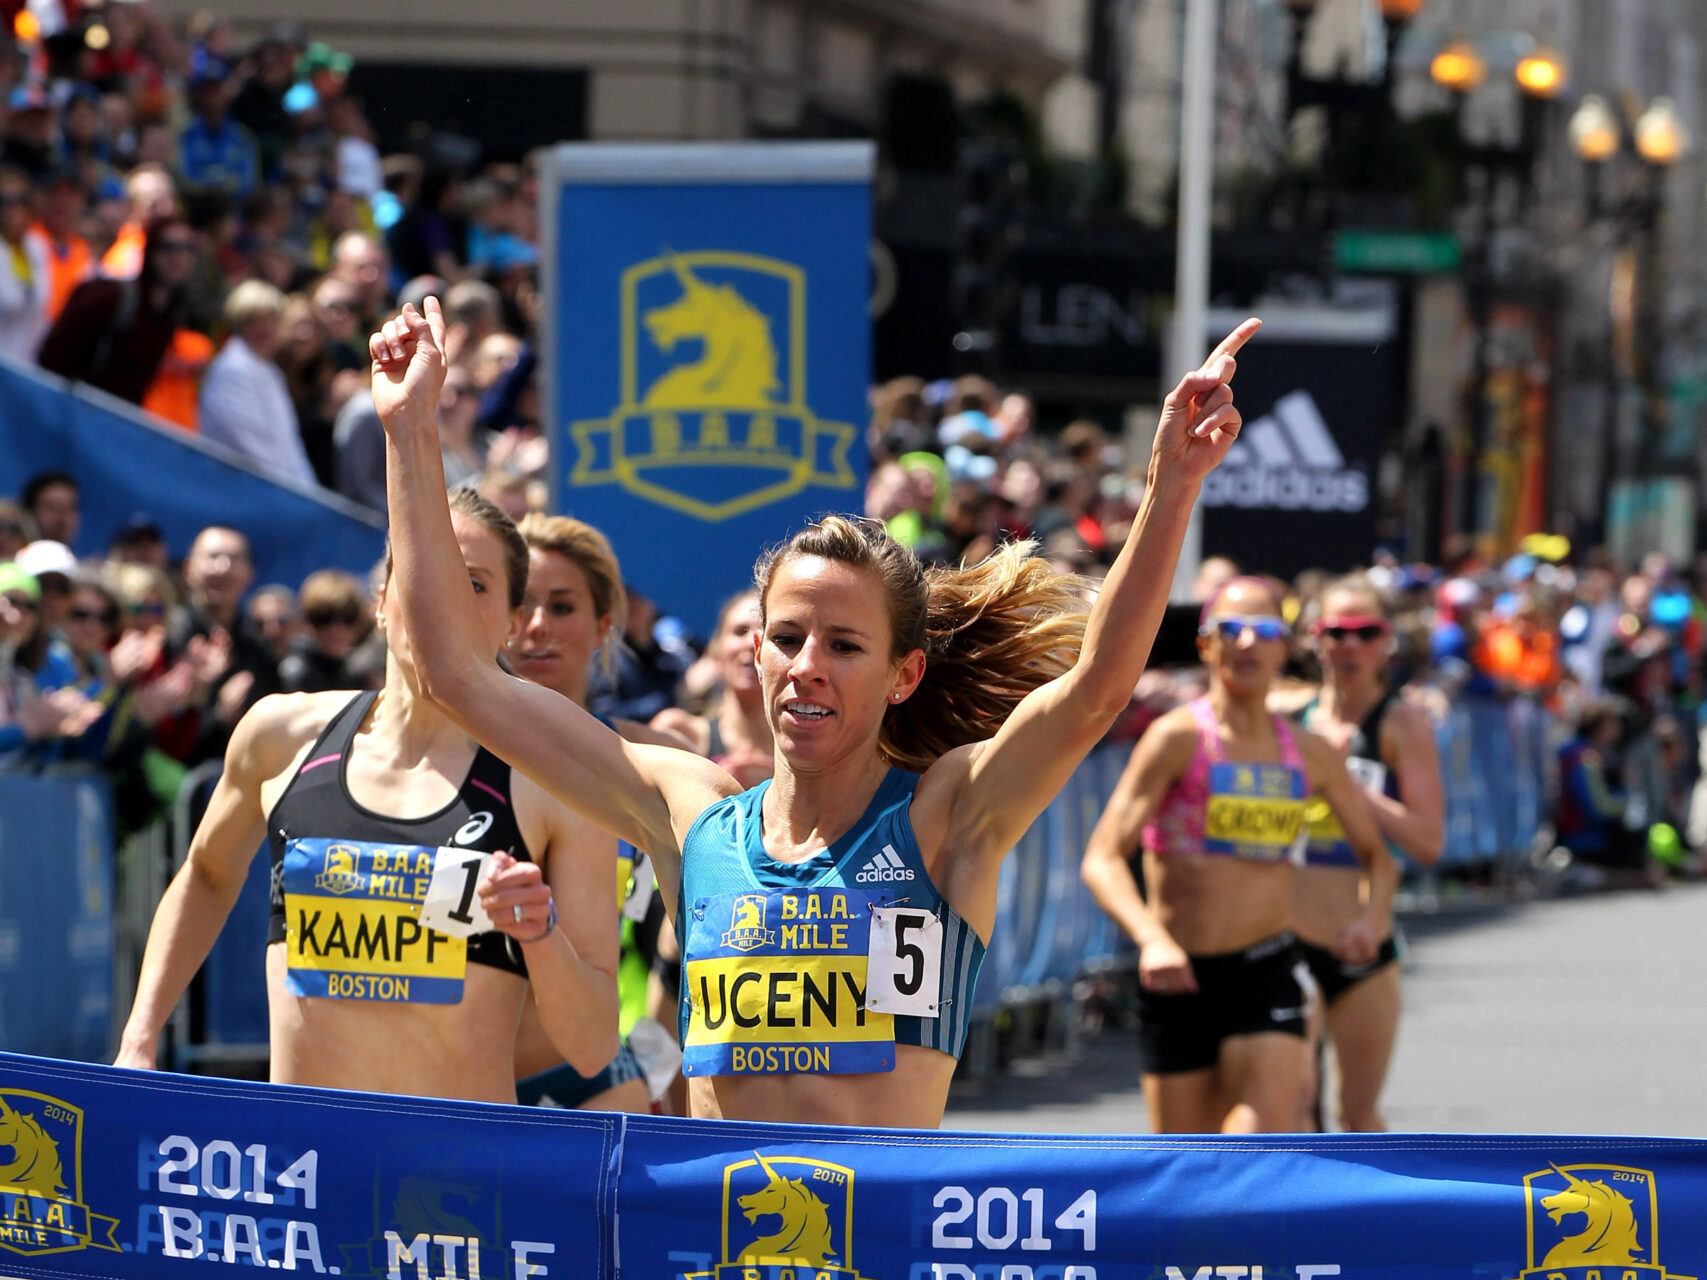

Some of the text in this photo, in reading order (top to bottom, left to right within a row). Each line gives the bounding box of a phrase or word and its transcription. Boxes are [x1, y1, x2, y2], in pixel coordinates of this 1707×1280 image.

[369, 875, 429, 899] MILE
[856, 867, 915, 883] adidas
[448, 859, 481, 925] 1
[781, 894, 855, 919] B.A.A.
[299, 909, 448, 964] KAMPF
[781, 924, 848, 949] MILE
[893, 914, 926, 996] 5
[328, 973, 410, 1000] BOSTON
[700, 971, 867, 1031] UCENY
[732, 1046, 830, 1072] BOSTON
[44, 1104, 75, 1126] 2014
[158, 1134, 318, 1209] 2014
[812, 1168, 846, 1187] 2014
[1612, 1171, 1646, 1185] 2014
[931, 1186, 1097, 1251] 2014
[0, 1226, 49, 1247] MILE
[159, 1205, 341, 1275] B.A.A.
